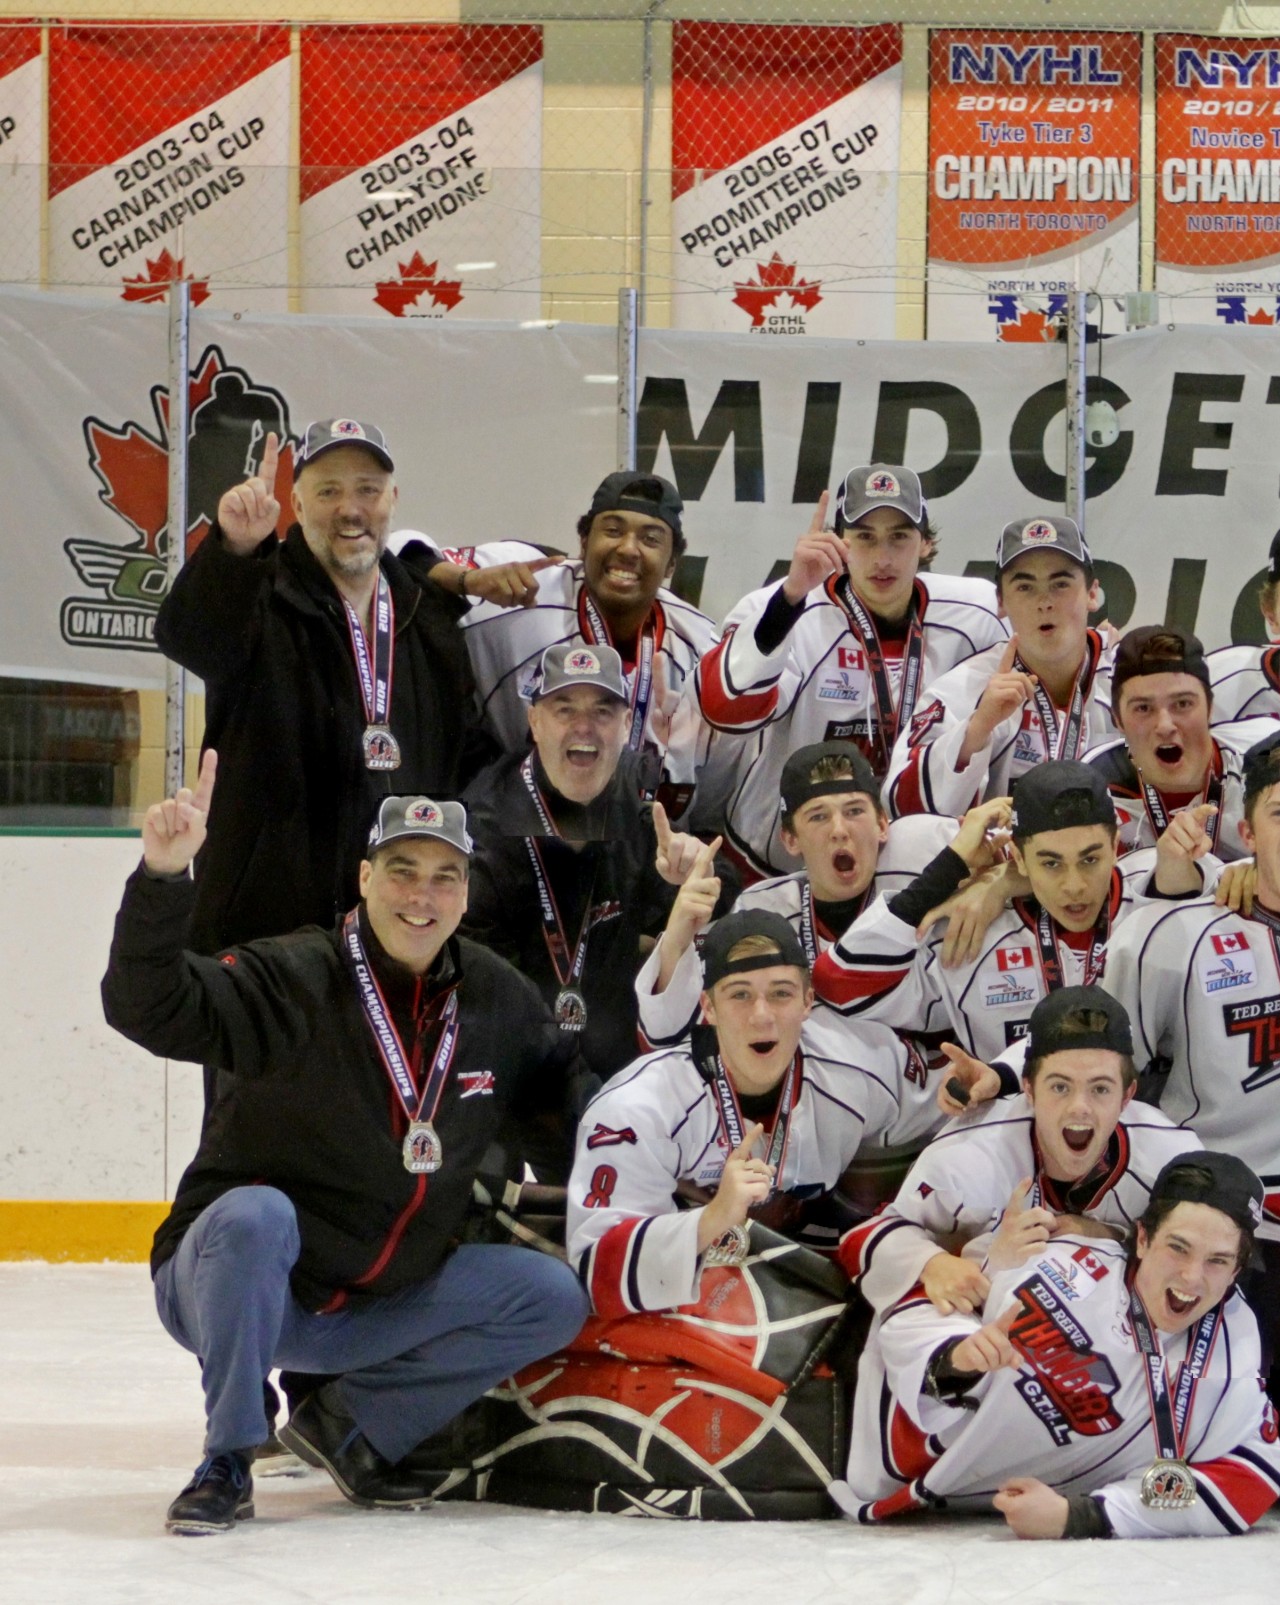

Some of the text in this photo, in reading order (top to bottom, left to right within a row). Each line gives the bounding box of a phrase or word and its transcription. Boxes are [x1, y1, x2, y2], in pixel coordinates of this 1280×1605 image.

[950, 43, 1121, 86] NYHL
[957, 96, 1114, 113] 2010/2011
[114, 111, 225, 192] 2003-04
[361, 117, 474, 193] 2003-04
[977, 122, 1093, 147] Tyke Tier 3
[1189, 127, 1264, 148] Novice
[725, 120, 830, 196] 2006-07
[934, 154, 1132, 202] CHAMPION
[72, 117, 265, 250] CARNATION CUP
[357, 147, 477, 231] PLAYOFF
[681, 124, 878, 252] PROMITTERE CUP
[98, 166, 245, 267] CHAMPIONS
[346, 172, 488, 270] CHAMPIONS
[714, 169, 861, 267] CHAMPIONS
[960, 213, 1107, 231] NORTH TORONTO
[1187, 214, 1246, 232] NORTH
[750, 327, 806, 335] CANADA
[769, 316, 806, 325] GTHL
[378, 601, 388, 633] 2018
[354, 628, 372, 708] CHAMPION
[377, 679, 386, 714] 2018
[348, 933, 412, 1098] OHF CHAMPIONSHIPS
[1232, 1003, 1261, 1020] TED
[436, 1032, 453, 1071] 2018
[411, 1162, 438, 1170] OHF
[1031, 1283, 1057, 1309] TED
[1052, 1308, 1087, 1348] REEVE
[1201, 1313, 1215, 1338] OHF
[1009, 1289, 1109, 1417] THUNDER
